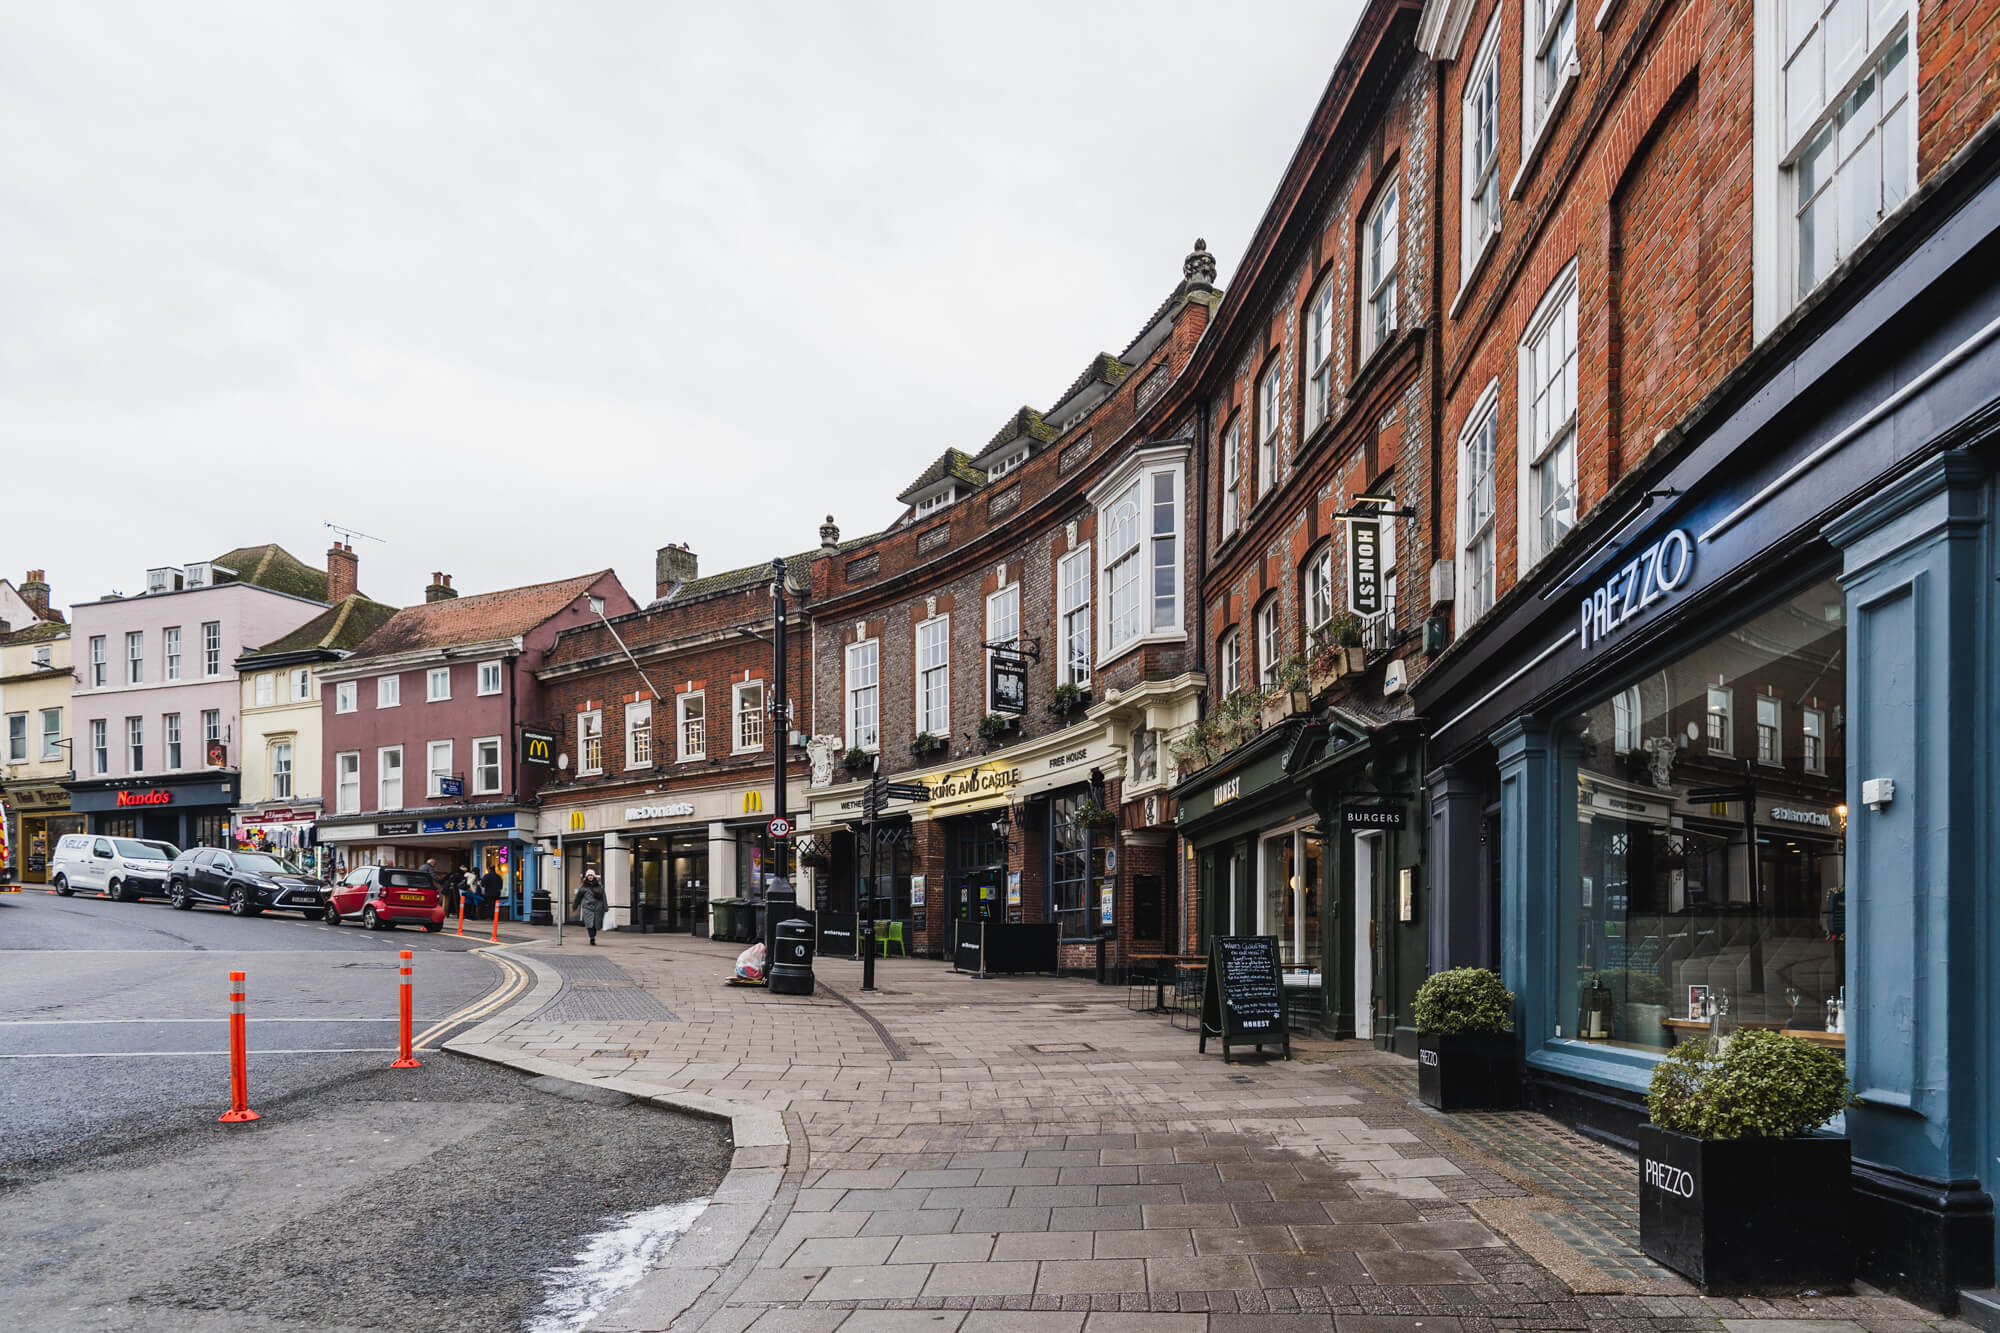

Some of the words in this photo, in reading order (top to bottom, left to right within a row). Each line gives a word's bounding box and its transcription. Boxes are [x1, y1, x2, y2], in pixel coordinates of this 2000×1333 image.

[1358, 530, 1375, 609] HONEST
[1581, 528, 1688, 650] PREZZO
[1049, 755, 1065, 768] FREE
[1066, 748, 1087, 763] HOUSE
[932, 783, 956, 800] KING
[958, 779, 979, 796] AND
[981, 767, 1020, 791] CASTLE
[1214, 776, 1240, 806] HONEST
[117, 788, 169, 807] Nando's
[772, 822, 788, 832] 20
[1347, 812, 1400, 823] BURGERS
[1243, 1020, 1270, 1028] HONEST
[1420, 1048, 1438, 1066] PREZZO
[1645, 1158, 1694, 1198] PREZZO
